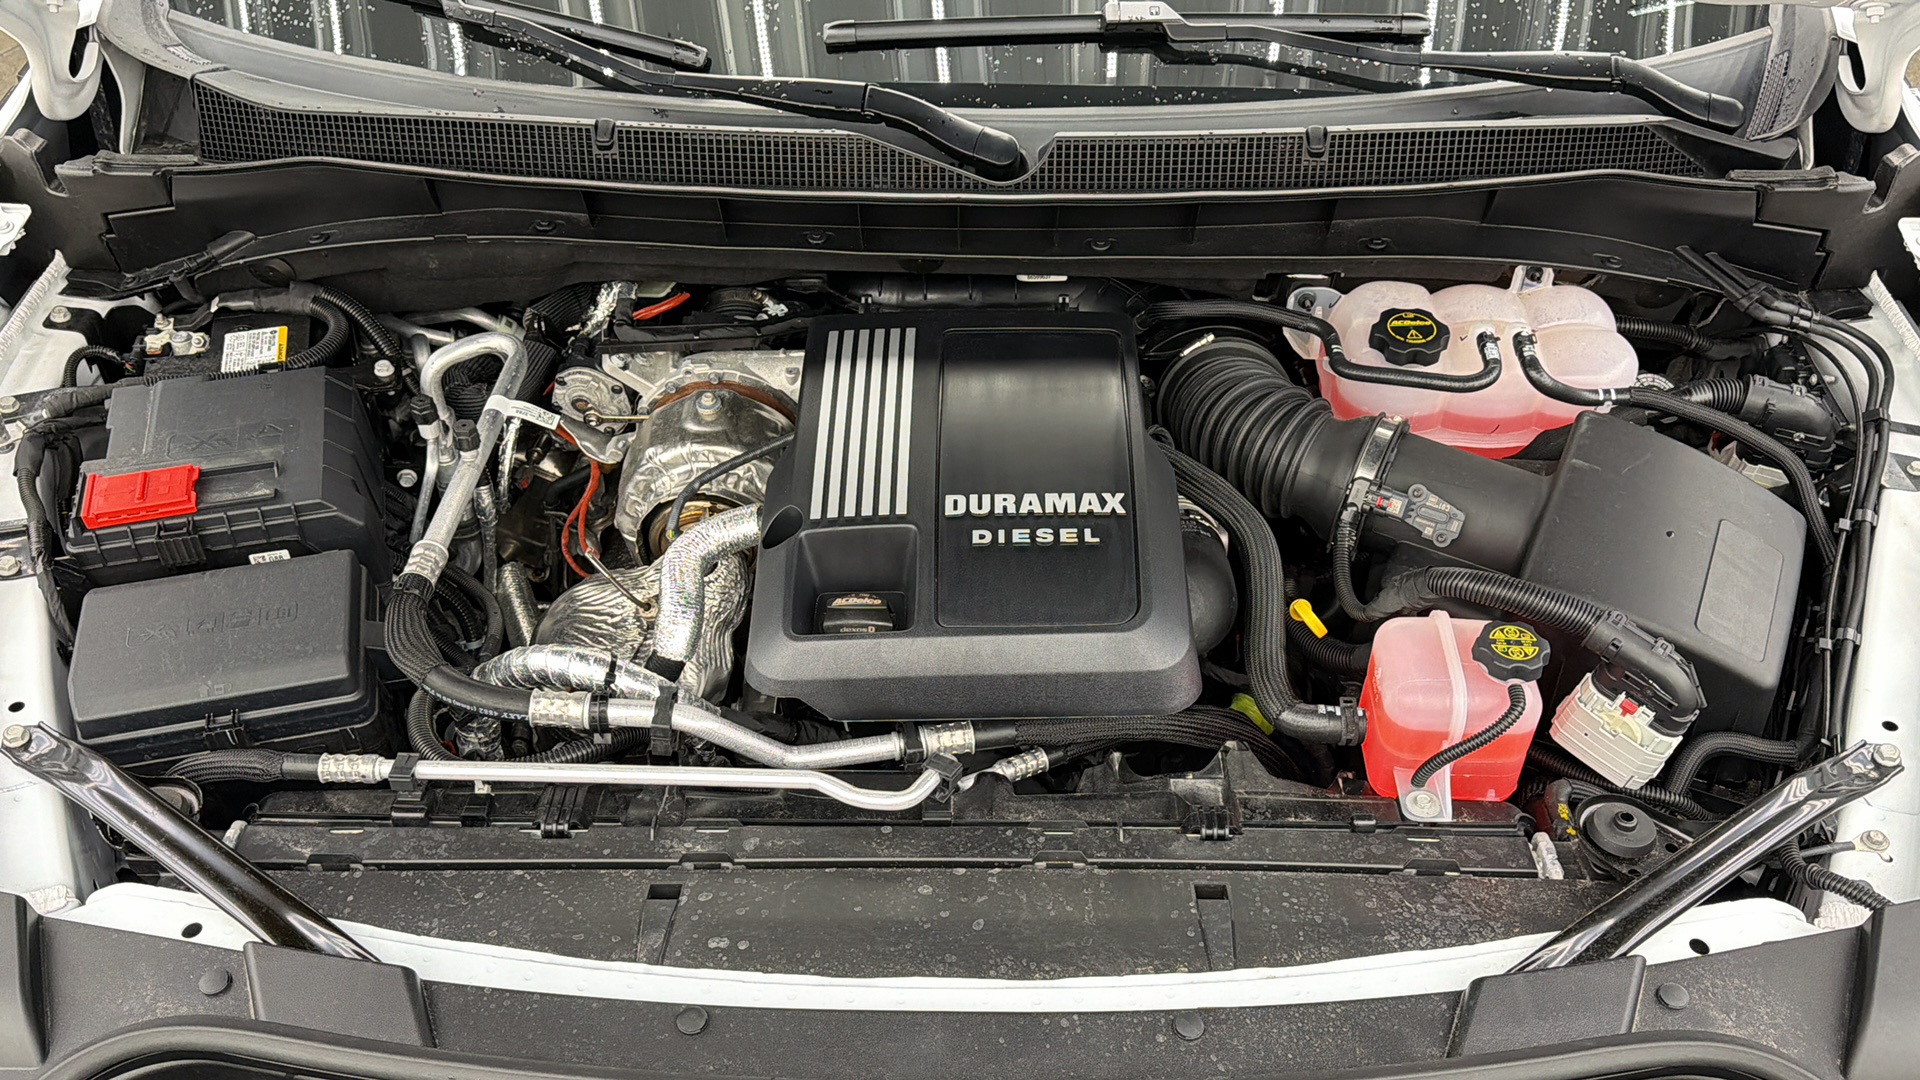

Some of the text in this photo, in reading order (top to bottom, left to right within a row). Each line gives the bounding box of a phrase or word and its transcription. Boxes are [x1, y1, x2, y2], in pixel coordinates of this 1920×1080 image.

[944, 492, 1127, 517] DURAMAX
[971, 527, 1101, 547] DIESEL
[831, 596, 882, 607] ACDelco
